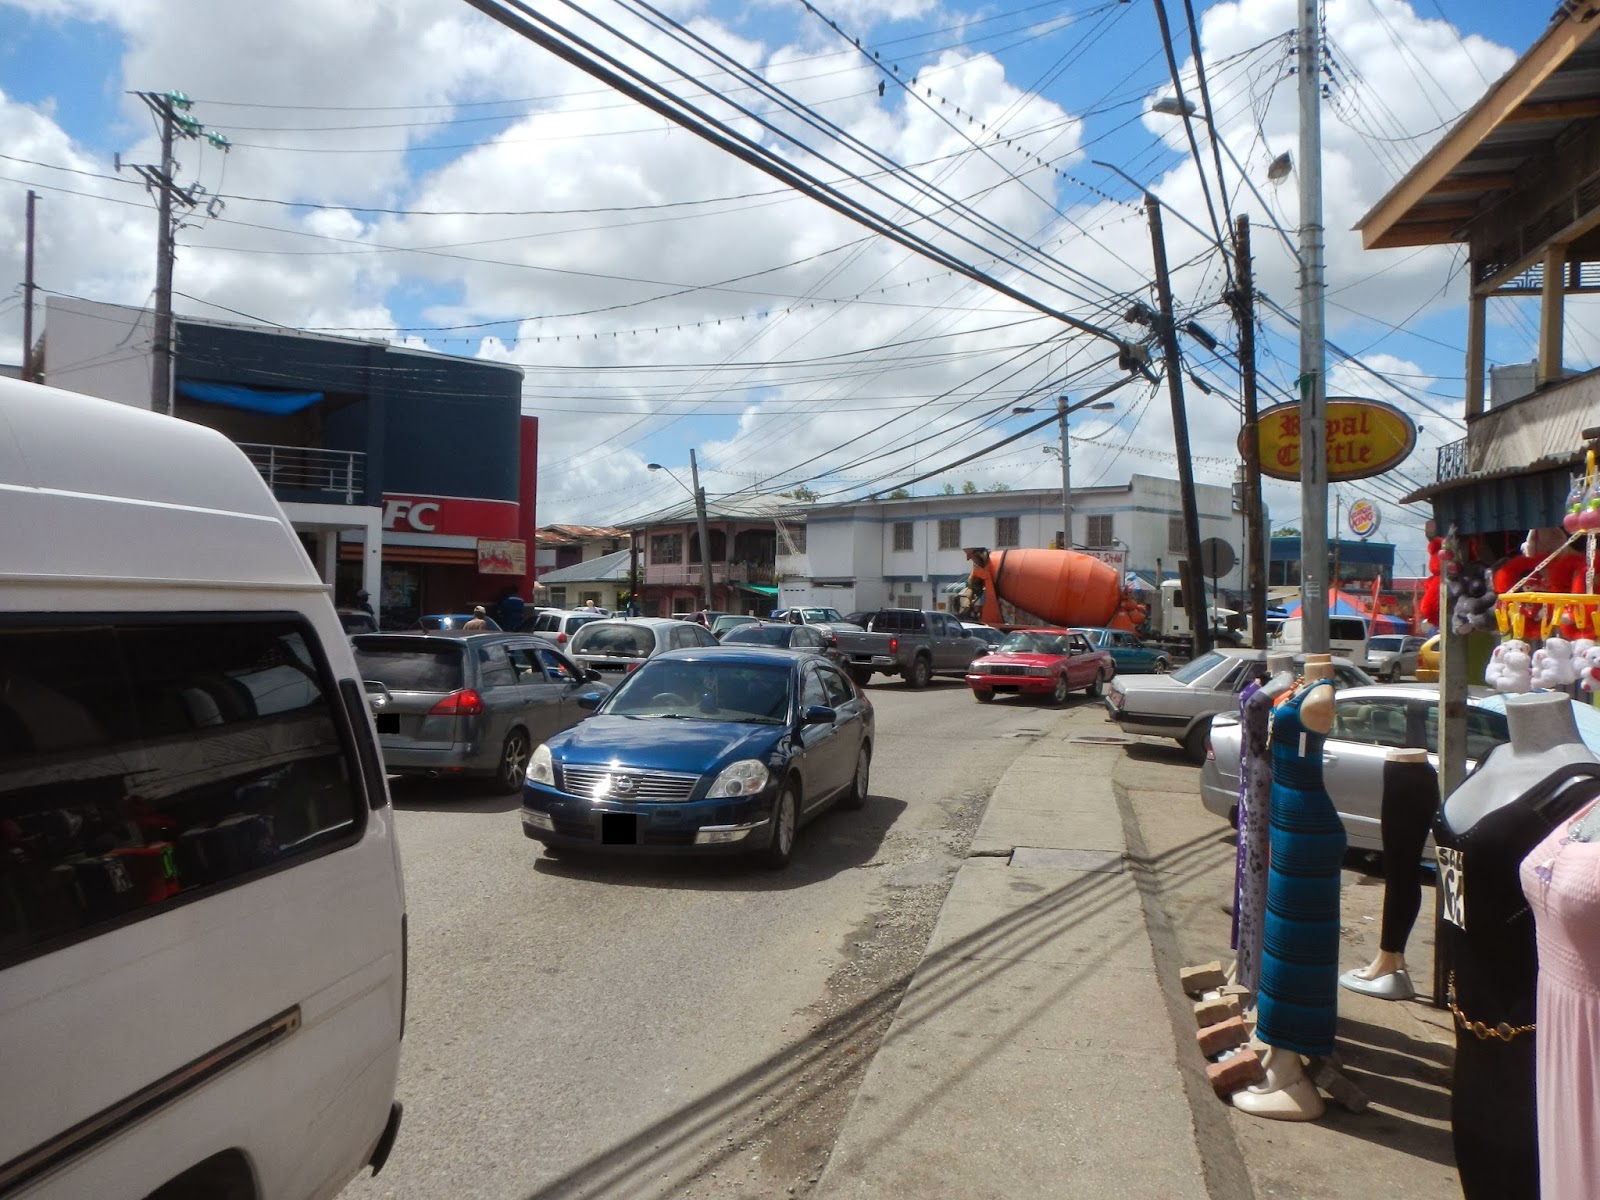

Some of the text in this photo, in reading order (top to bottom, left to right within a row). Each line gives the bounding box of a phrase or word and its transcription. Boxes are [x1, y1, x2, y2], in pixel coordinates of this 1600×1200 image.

[1279, 411, 1371, 442] Ryal
[1277, 440, 1370, 467] Ctle
[382, 500, 440, 531] FC
